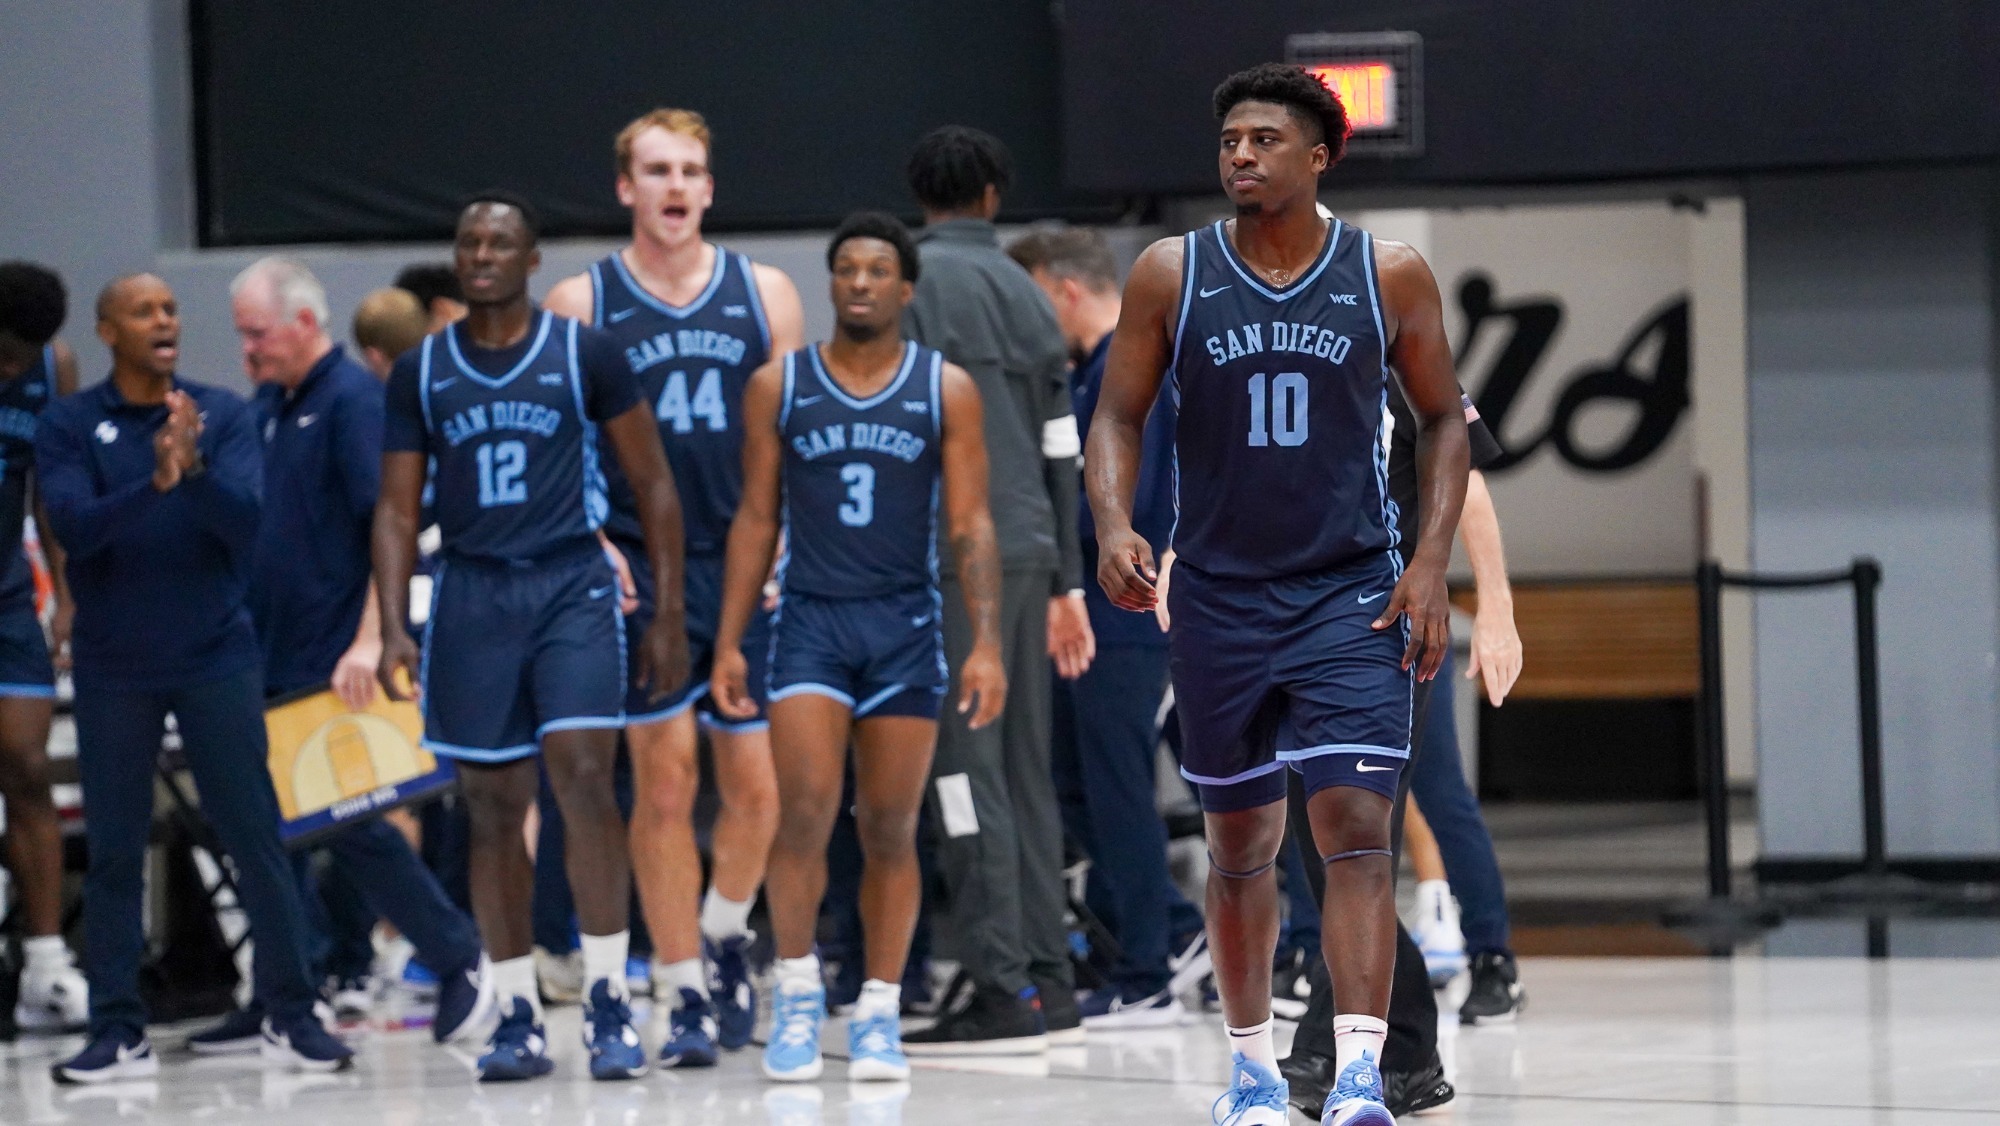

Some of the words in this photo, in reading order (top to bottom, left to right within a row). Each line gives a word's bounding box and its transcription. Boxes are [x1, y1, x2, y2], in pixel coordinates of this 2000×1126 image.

[625, 331, 676, 375] SAN
[676, 328, 747, 368] DIEGO
[1206, 323, 1265, 366] SAN
[1271, 321, 1352, 366] DIEGO
[442, 403, 488, 447] SAN
[490, 400, 562, 439] DIEGO
[656, 367, 728, 434] 44
[1247, 372, 1309, 447] 10
[792, 423, 846, 461] SAN
[850, 422, 927, 464] DIEGO
[476, 439, 529, 508] 12
[838, 462, 876, 527] 3
